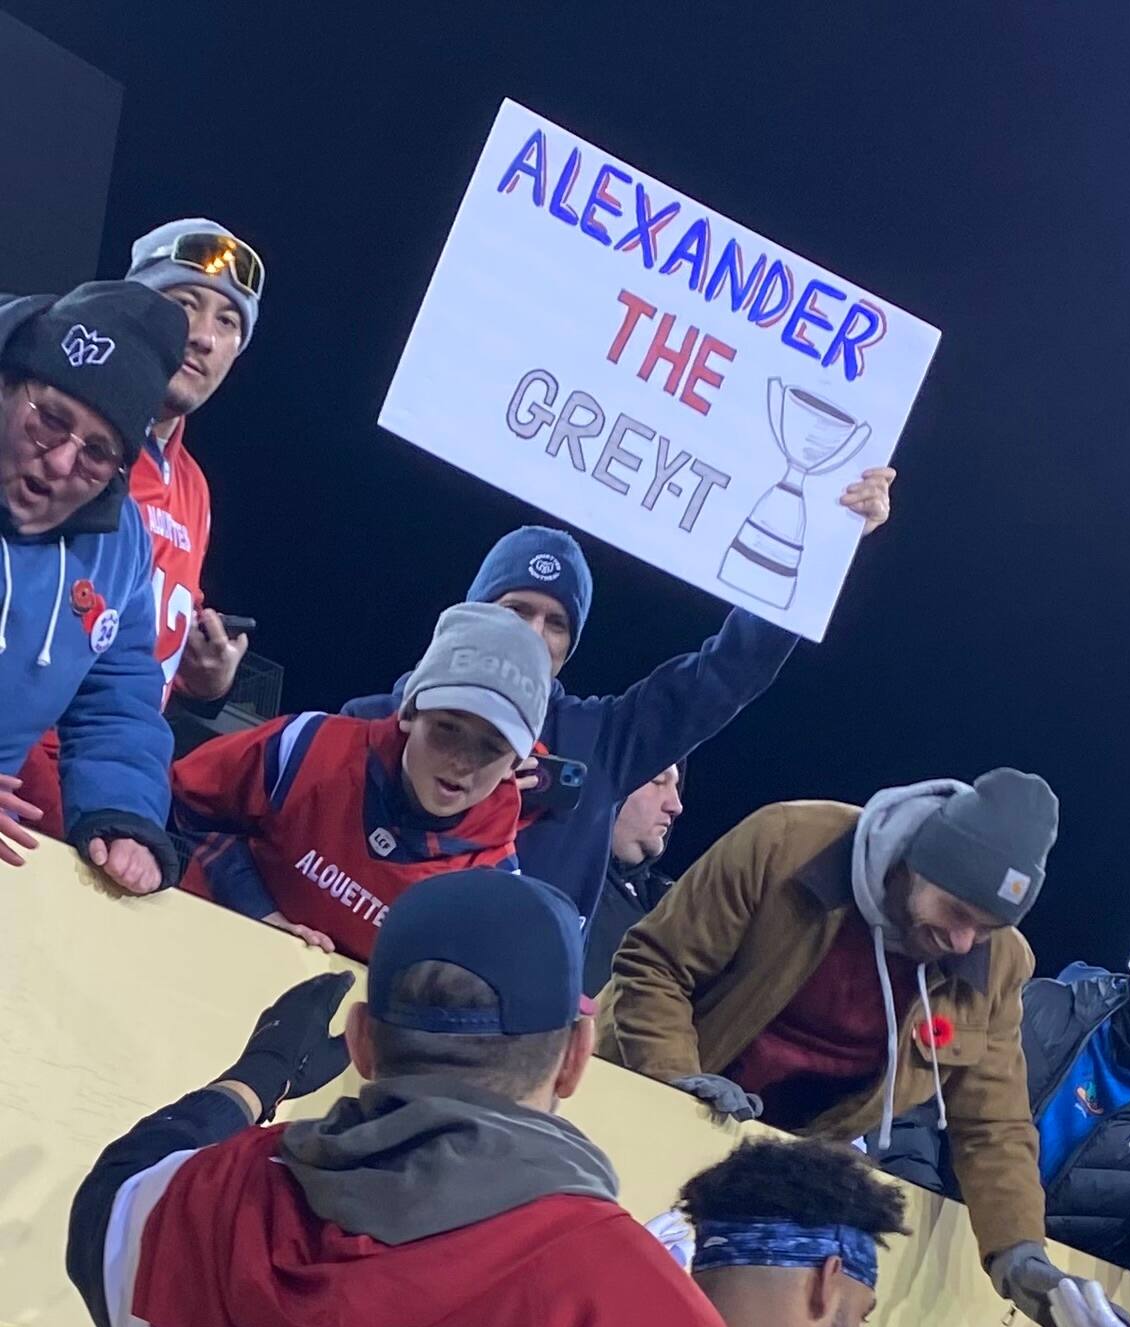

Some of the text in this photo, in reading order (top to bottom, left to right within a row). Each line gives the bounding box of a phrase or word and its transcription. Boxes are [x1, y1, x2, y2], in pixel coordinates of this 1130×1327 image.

[497, 128, 887, 381] ALEXANDER
[607, 288, 737, 416] THE
[294, 849, 390, 928] ALOUETTE
[374, 833, 391, 850] LCF
